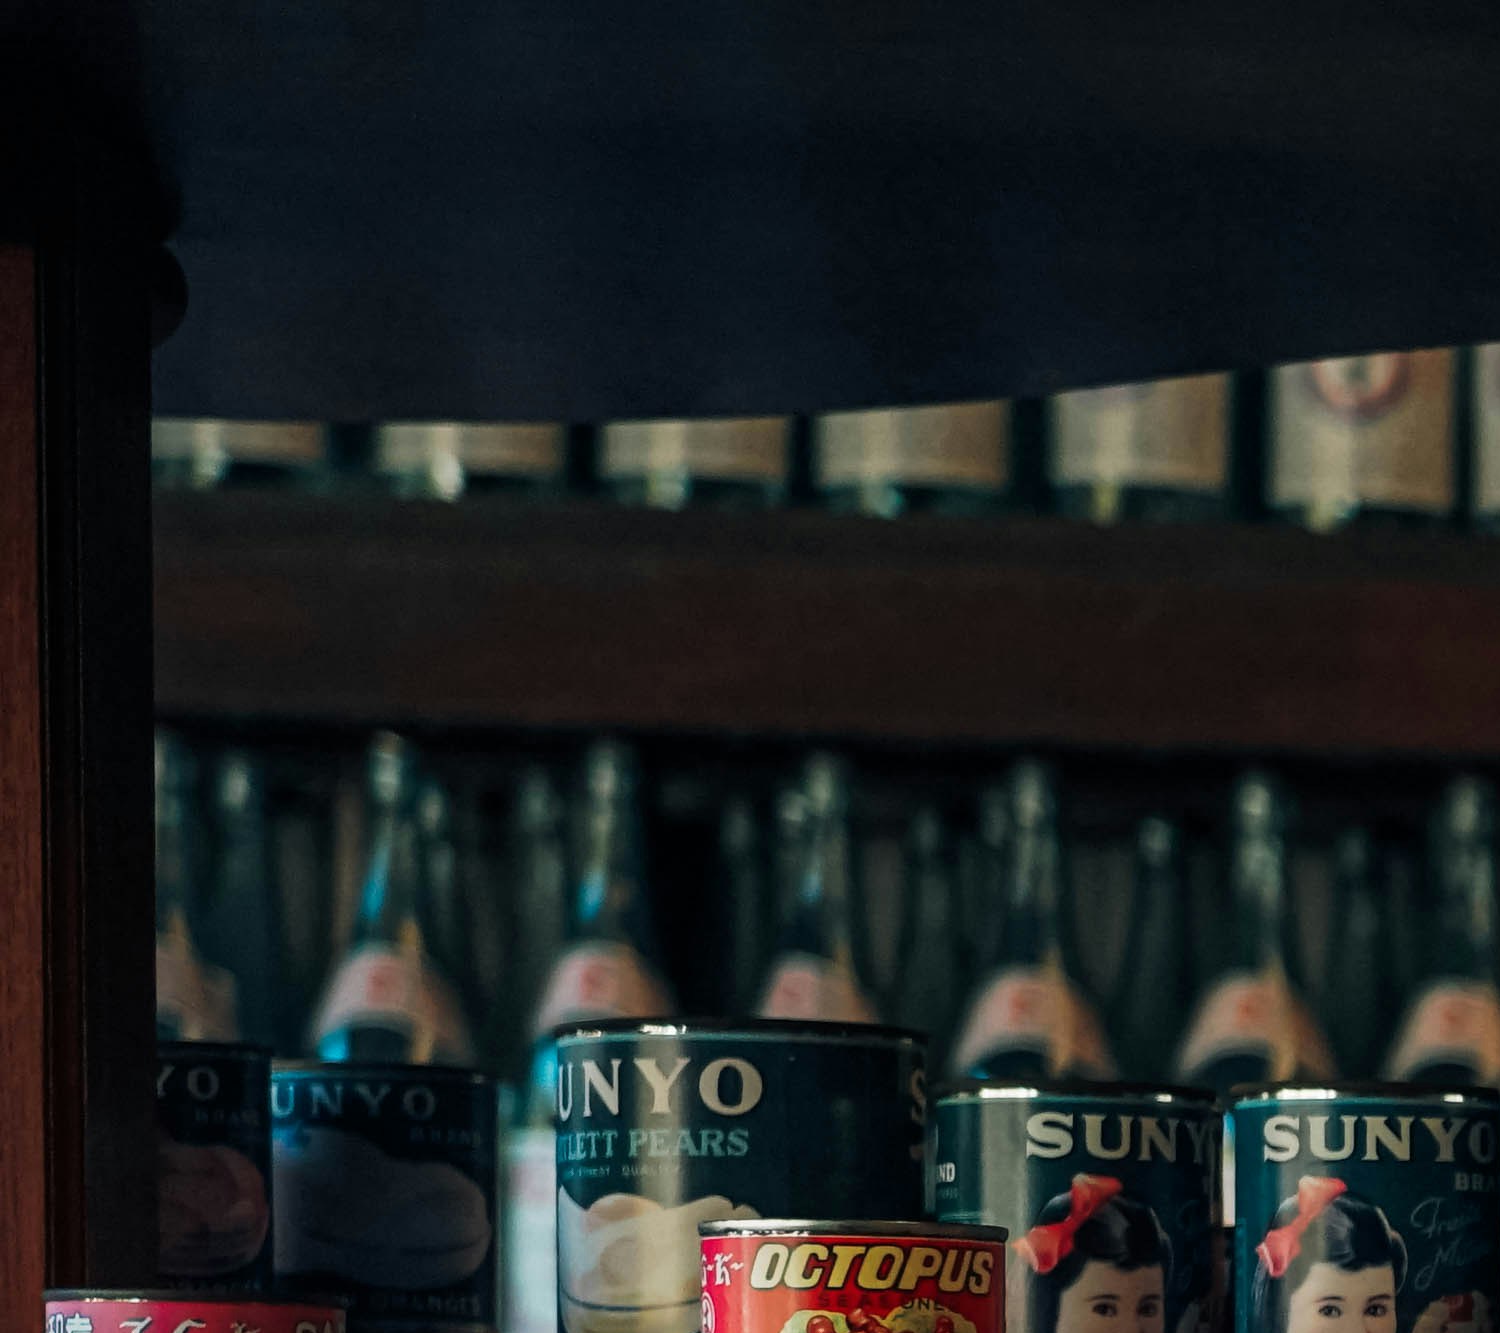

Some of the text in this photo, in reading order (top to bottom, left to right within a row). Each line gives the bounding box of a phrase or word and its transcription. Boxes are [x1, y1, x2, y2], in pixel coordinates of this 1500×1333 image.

[628, 1126, 750, 1159] PEARS
[1263, 1113, 1495, 1164] SUNYO
[750, 1241, 995, 1297] OCTOPUS
